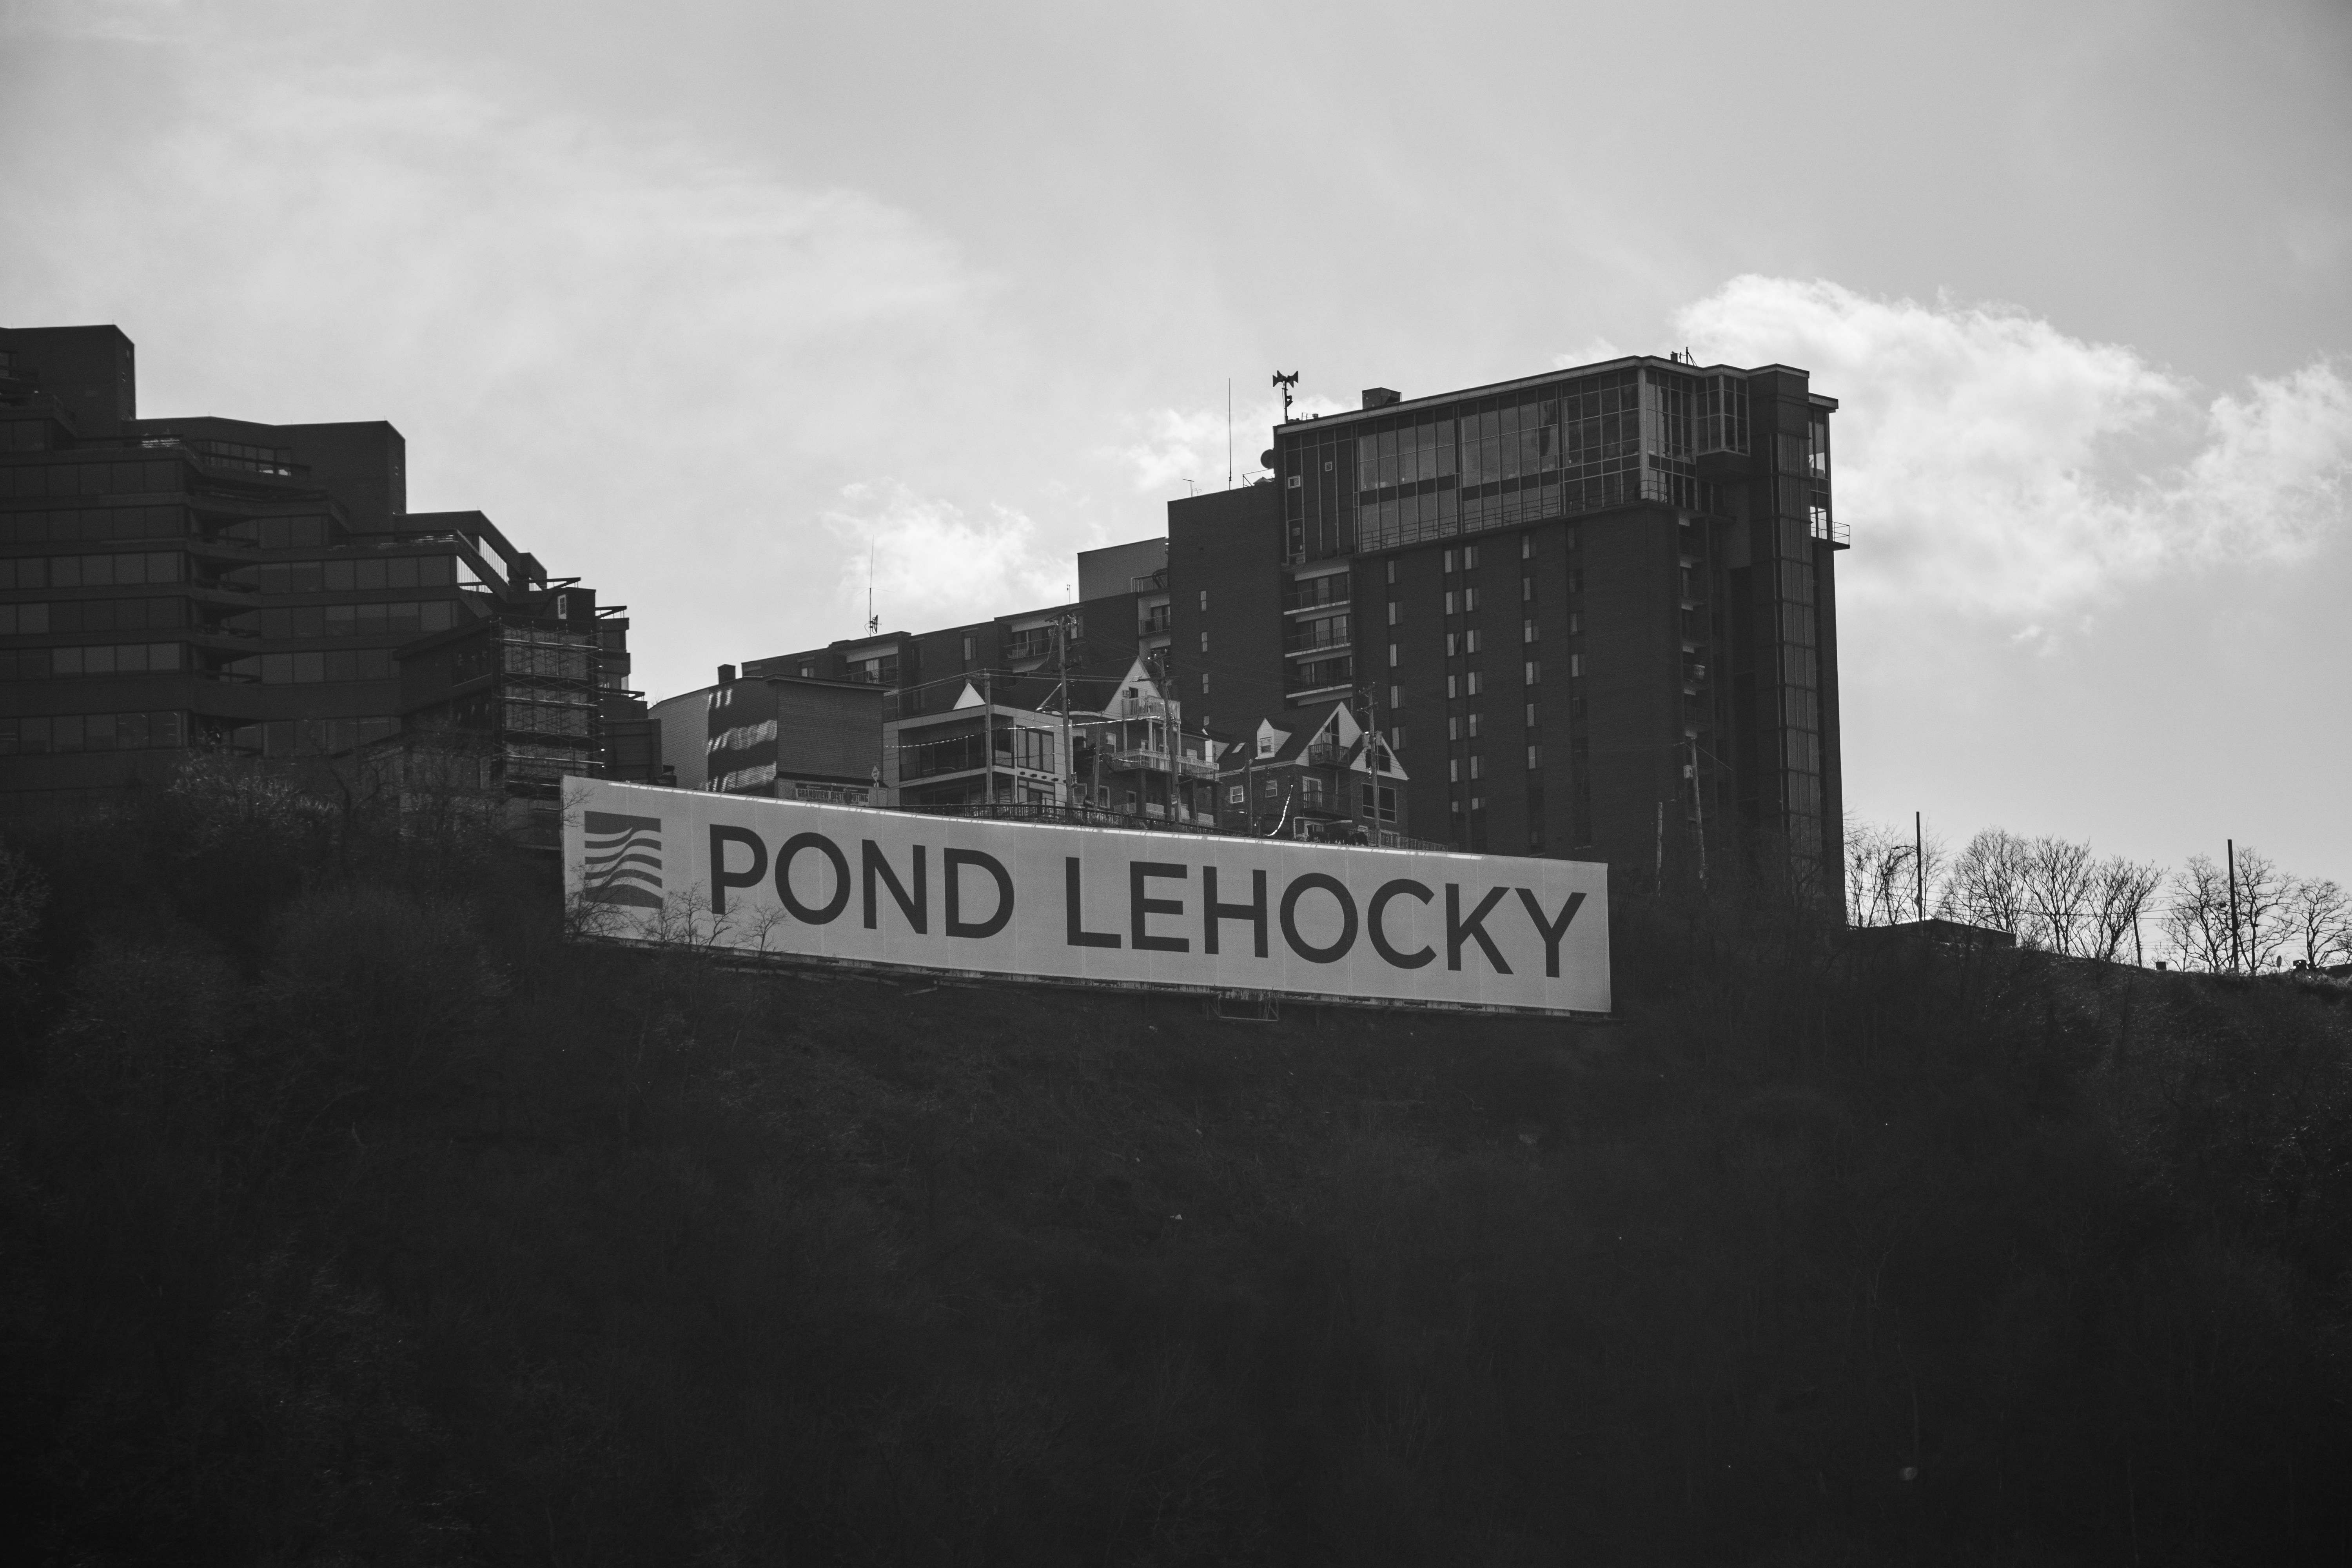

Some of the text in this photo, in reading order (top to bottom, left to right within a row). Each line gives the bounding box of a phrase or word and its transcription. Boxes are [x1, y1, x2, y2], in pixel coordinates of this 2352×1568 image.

[798, 789, 869, 802] GRANDVIEW DISTUTING
[710, 824, 1586, 978] POND LEHOCKY
